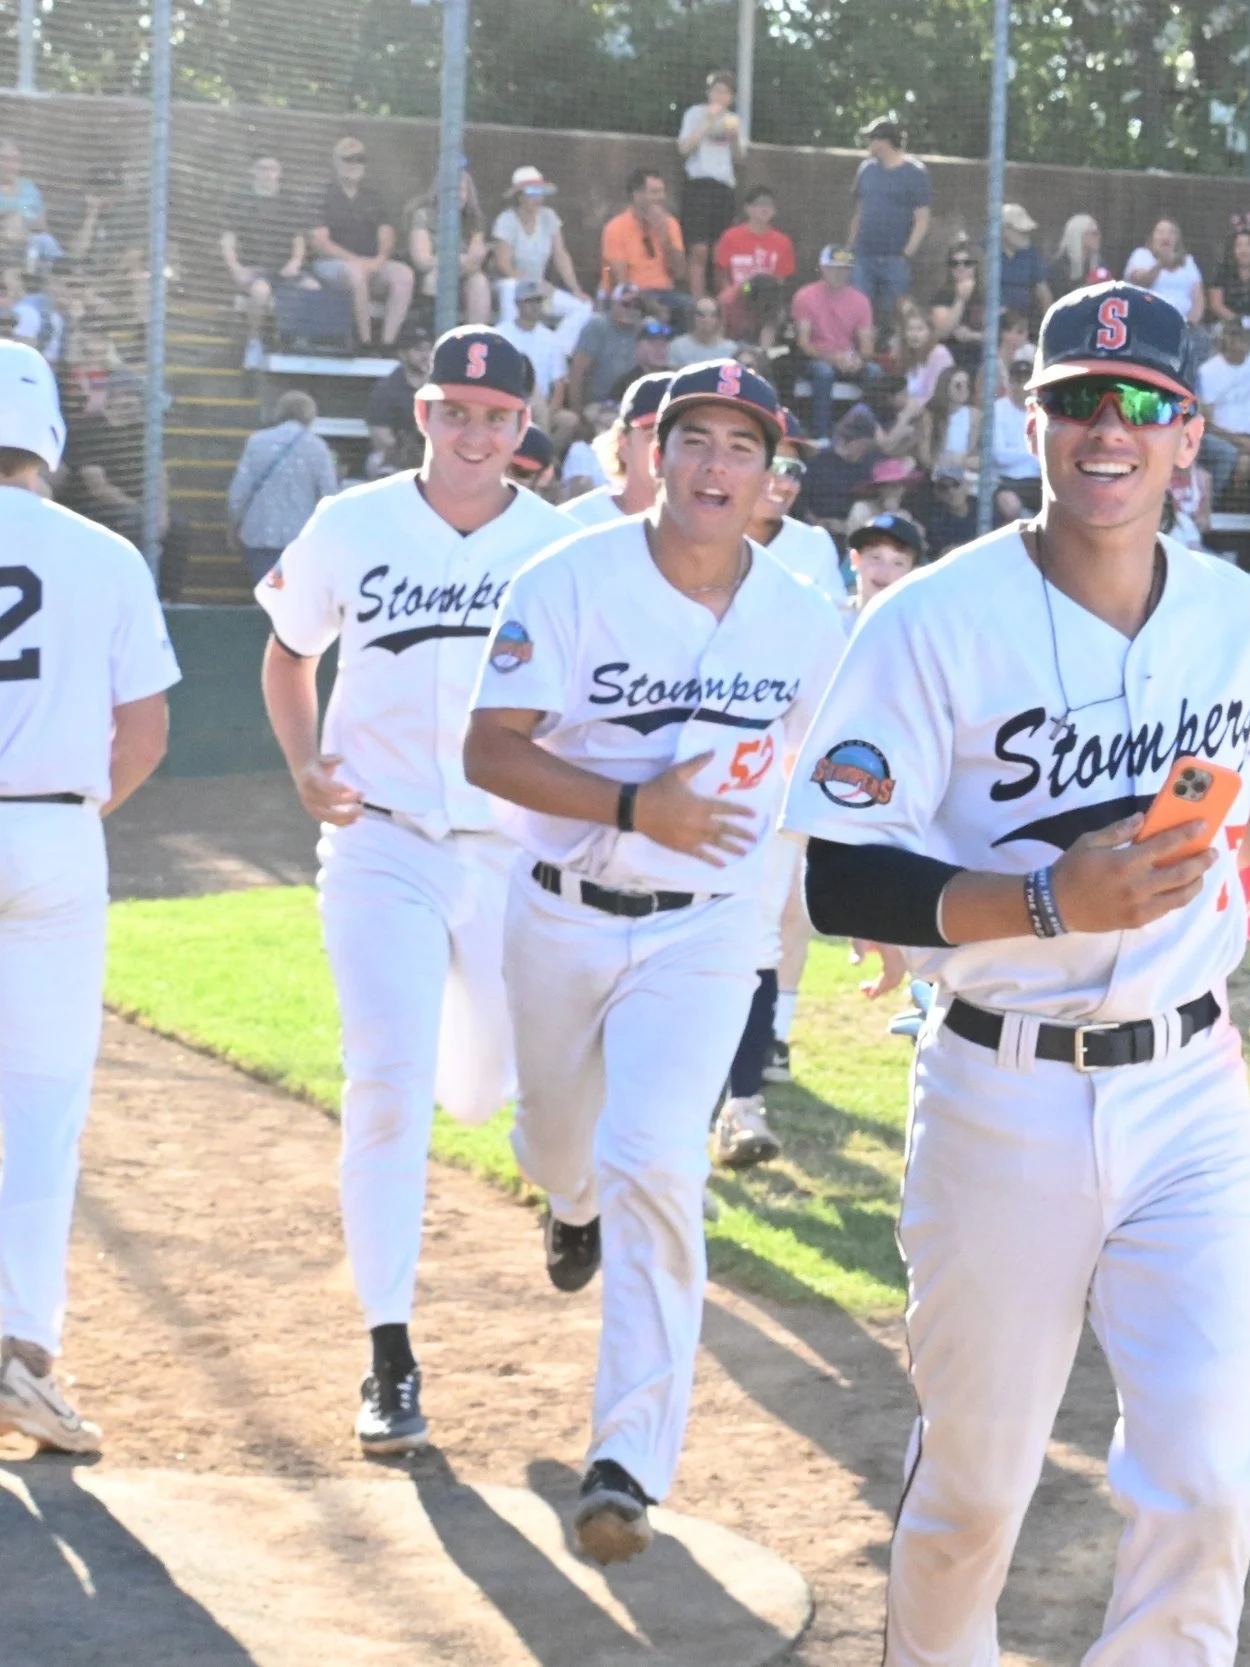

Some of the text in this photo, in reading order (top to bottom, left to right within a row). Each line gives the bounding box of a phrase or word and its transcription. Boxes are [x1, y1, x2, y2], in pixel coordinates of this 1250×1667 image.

[1096, 297, 1129, 350] S
[465, 342, 489, 379] S
[716, 363, 743, 396] S
[0, 564, 43, 683] 2
[589, 662, 801, 713] Stompers
